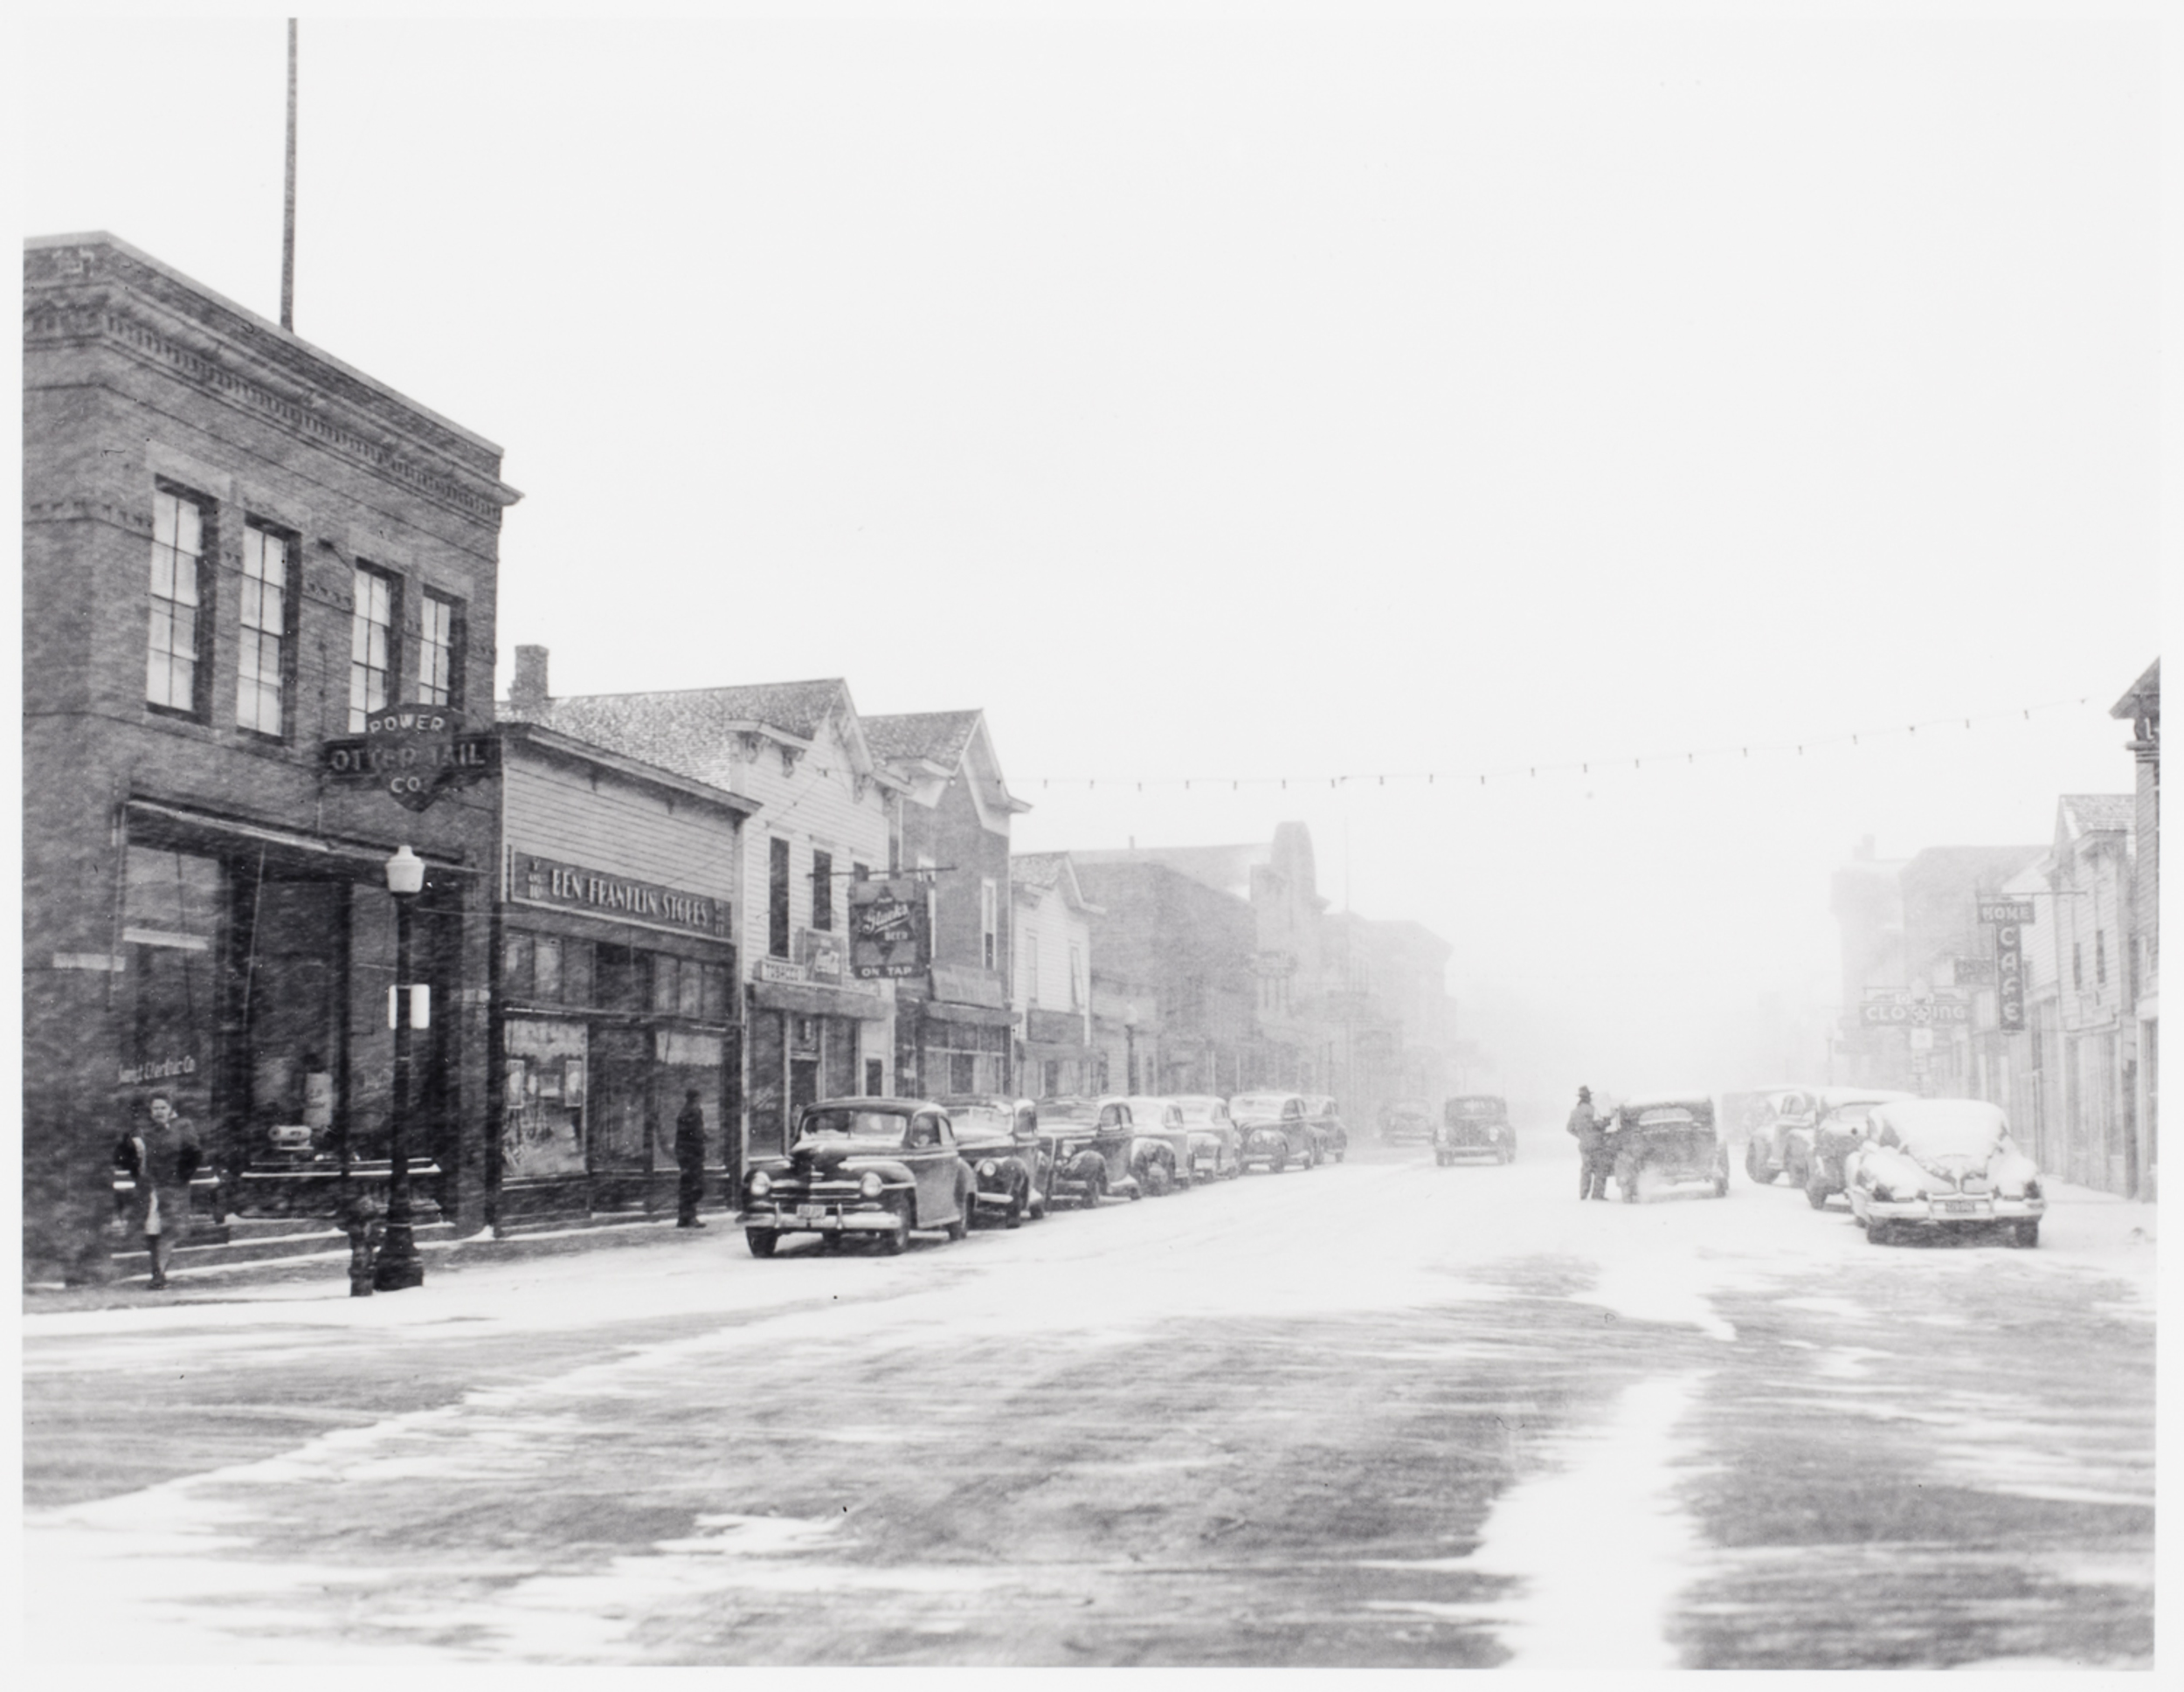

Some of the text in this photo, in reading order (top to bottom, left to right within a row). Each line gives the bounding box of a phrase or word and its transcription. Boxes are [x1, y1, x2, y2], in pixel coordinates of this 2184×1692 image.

[370, 713, 445, 734] POWER
[331, 742, 486, 771] OTTER TAIL
[552, 868, 582, 899] BEN
[588, 877, 657, 915] FRANKLIN
[662, 893, 708, 927] STORES
[1981, 906, 2030, 920] HOME
[860, 966, 913, 977] ON TAP
[2000, 926, 2022, 1021] CAFE
[1866, 1005, 1966, 1021] CLOING
